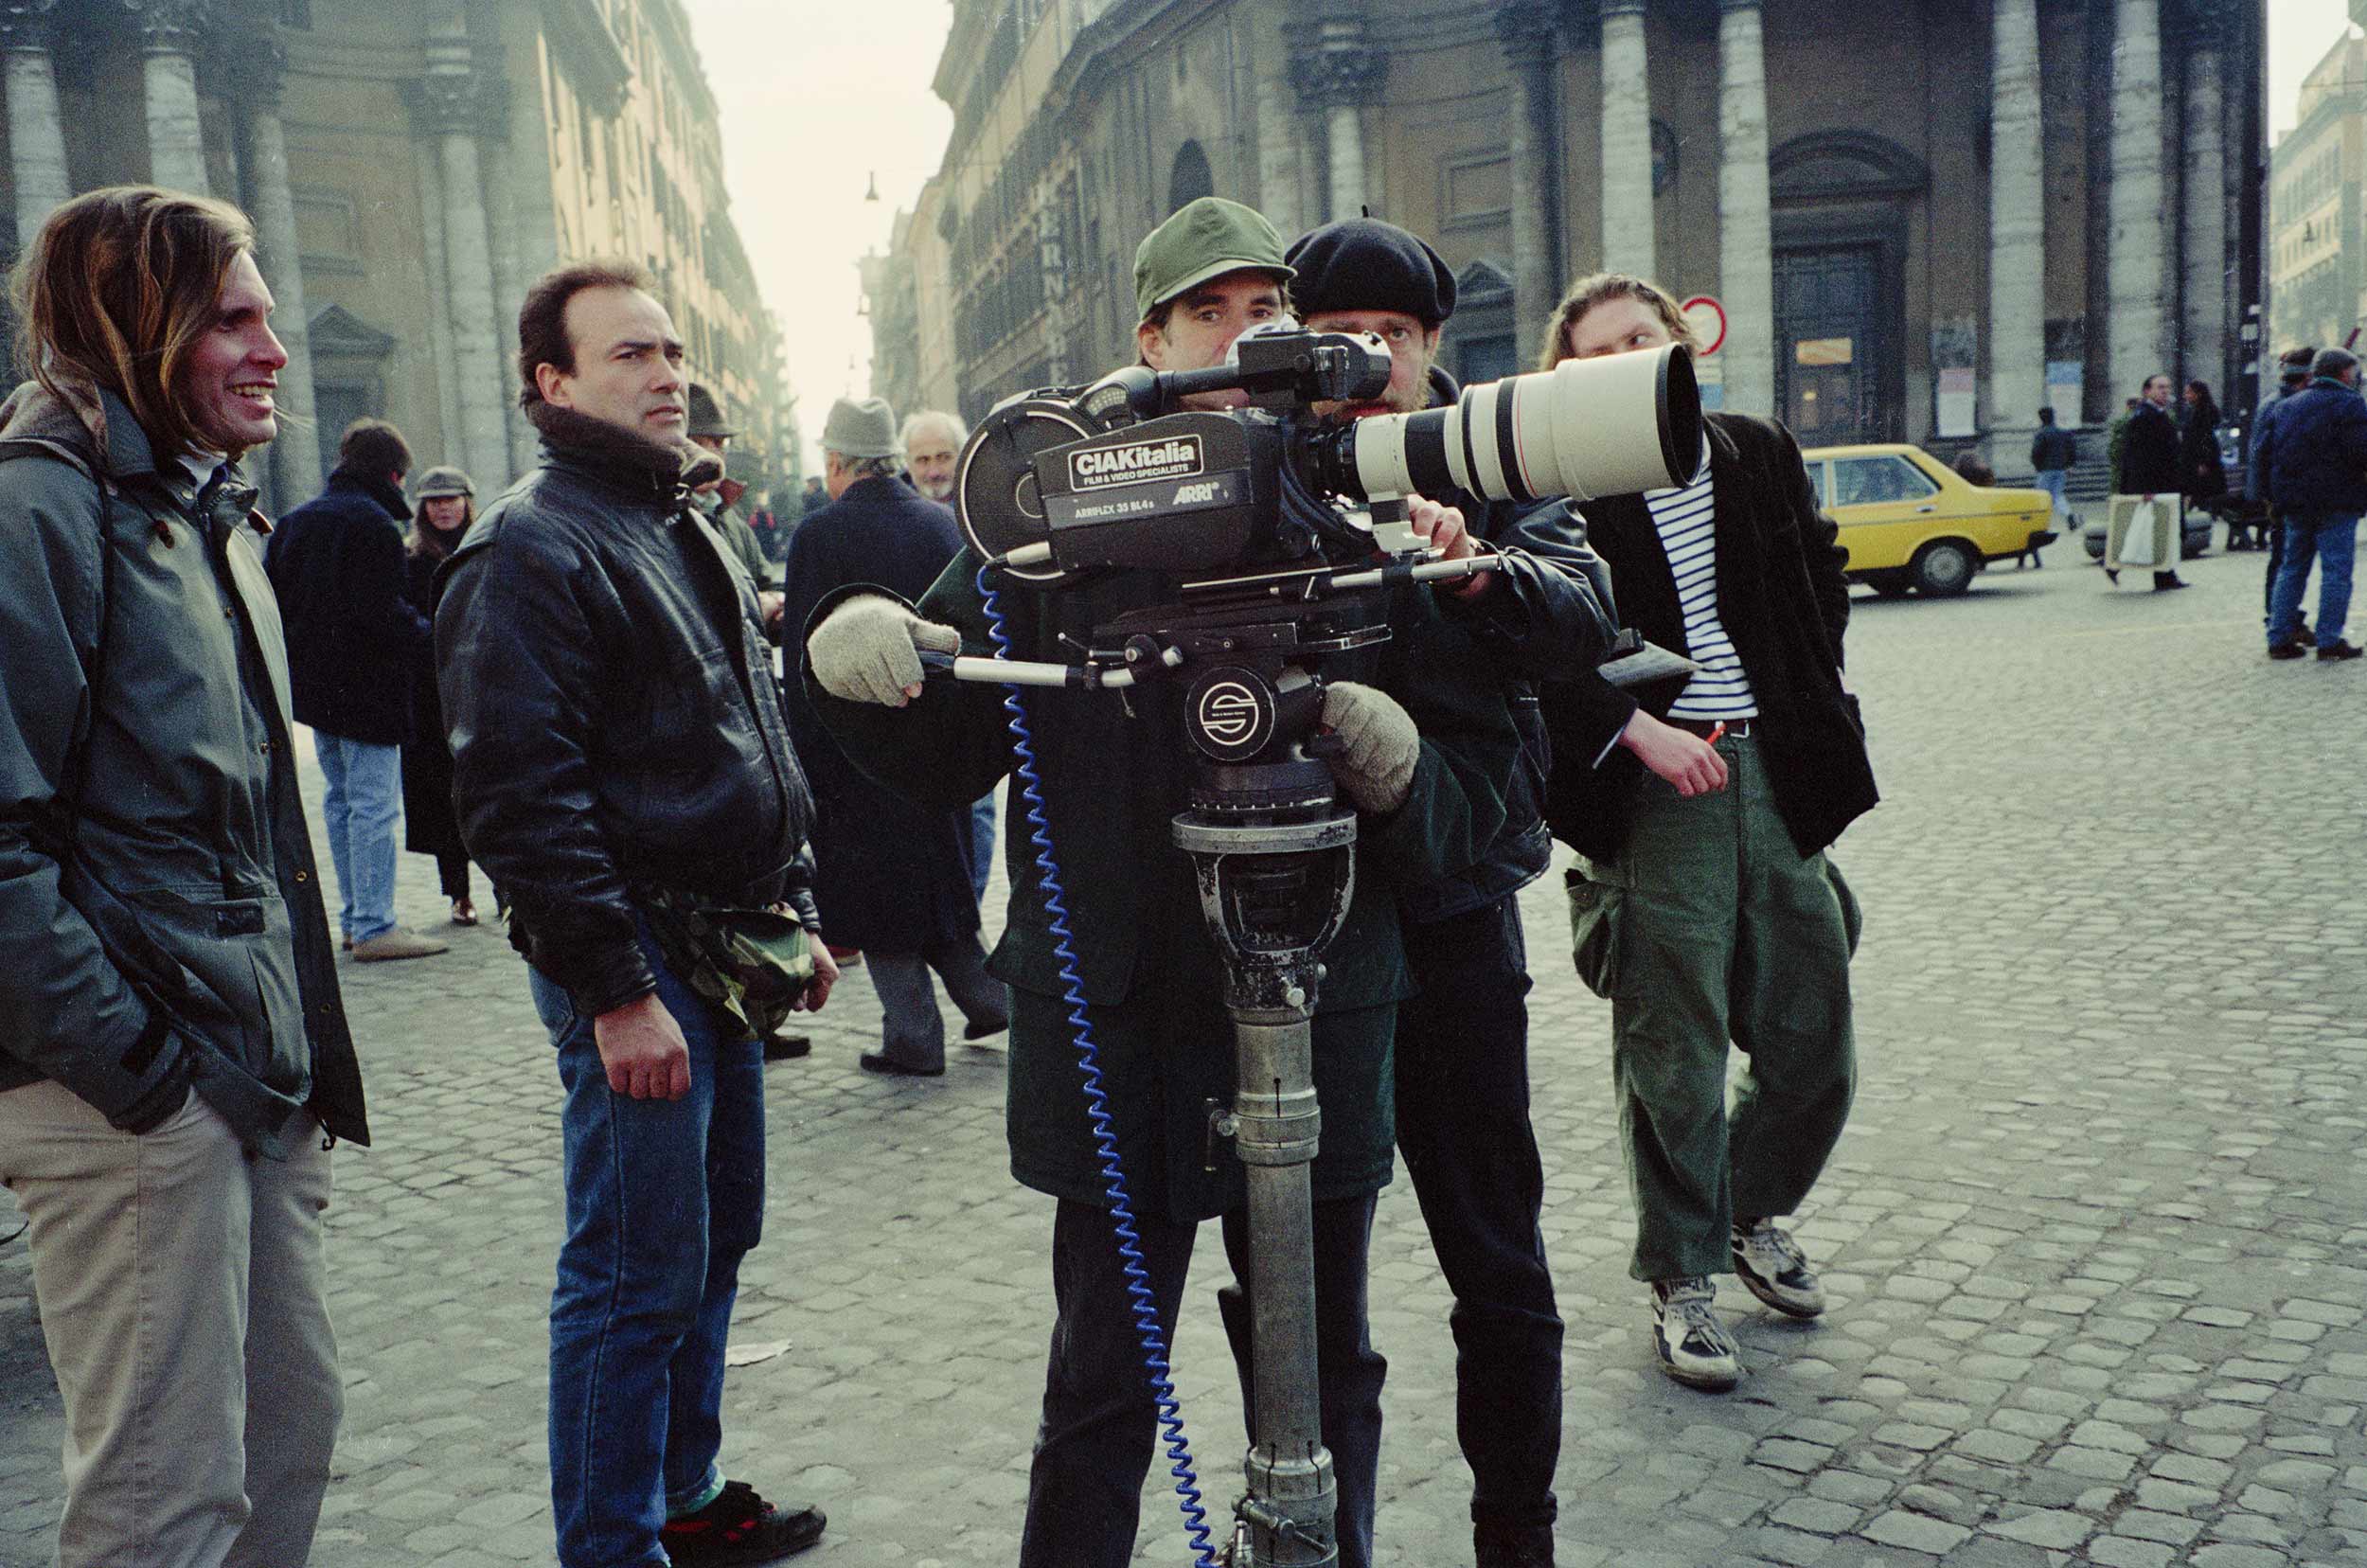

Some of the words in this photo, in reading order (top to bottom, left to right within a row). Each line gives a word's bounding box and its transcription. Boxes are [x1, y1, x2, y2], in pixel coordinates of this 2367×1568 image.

[1077, 441, 1194, 475] CIAKitalia
[1084, 475, 1103, 485] FILM
[1103, 474, 1111, 483] &
[1112, 471, 1136, 482] VIDEO
[1136, 463, 1189, 478] SPECIALISTS
[1076, 504, 1115, 518] ARRIFLEX
[1117, 502, 1129, 512] 35
